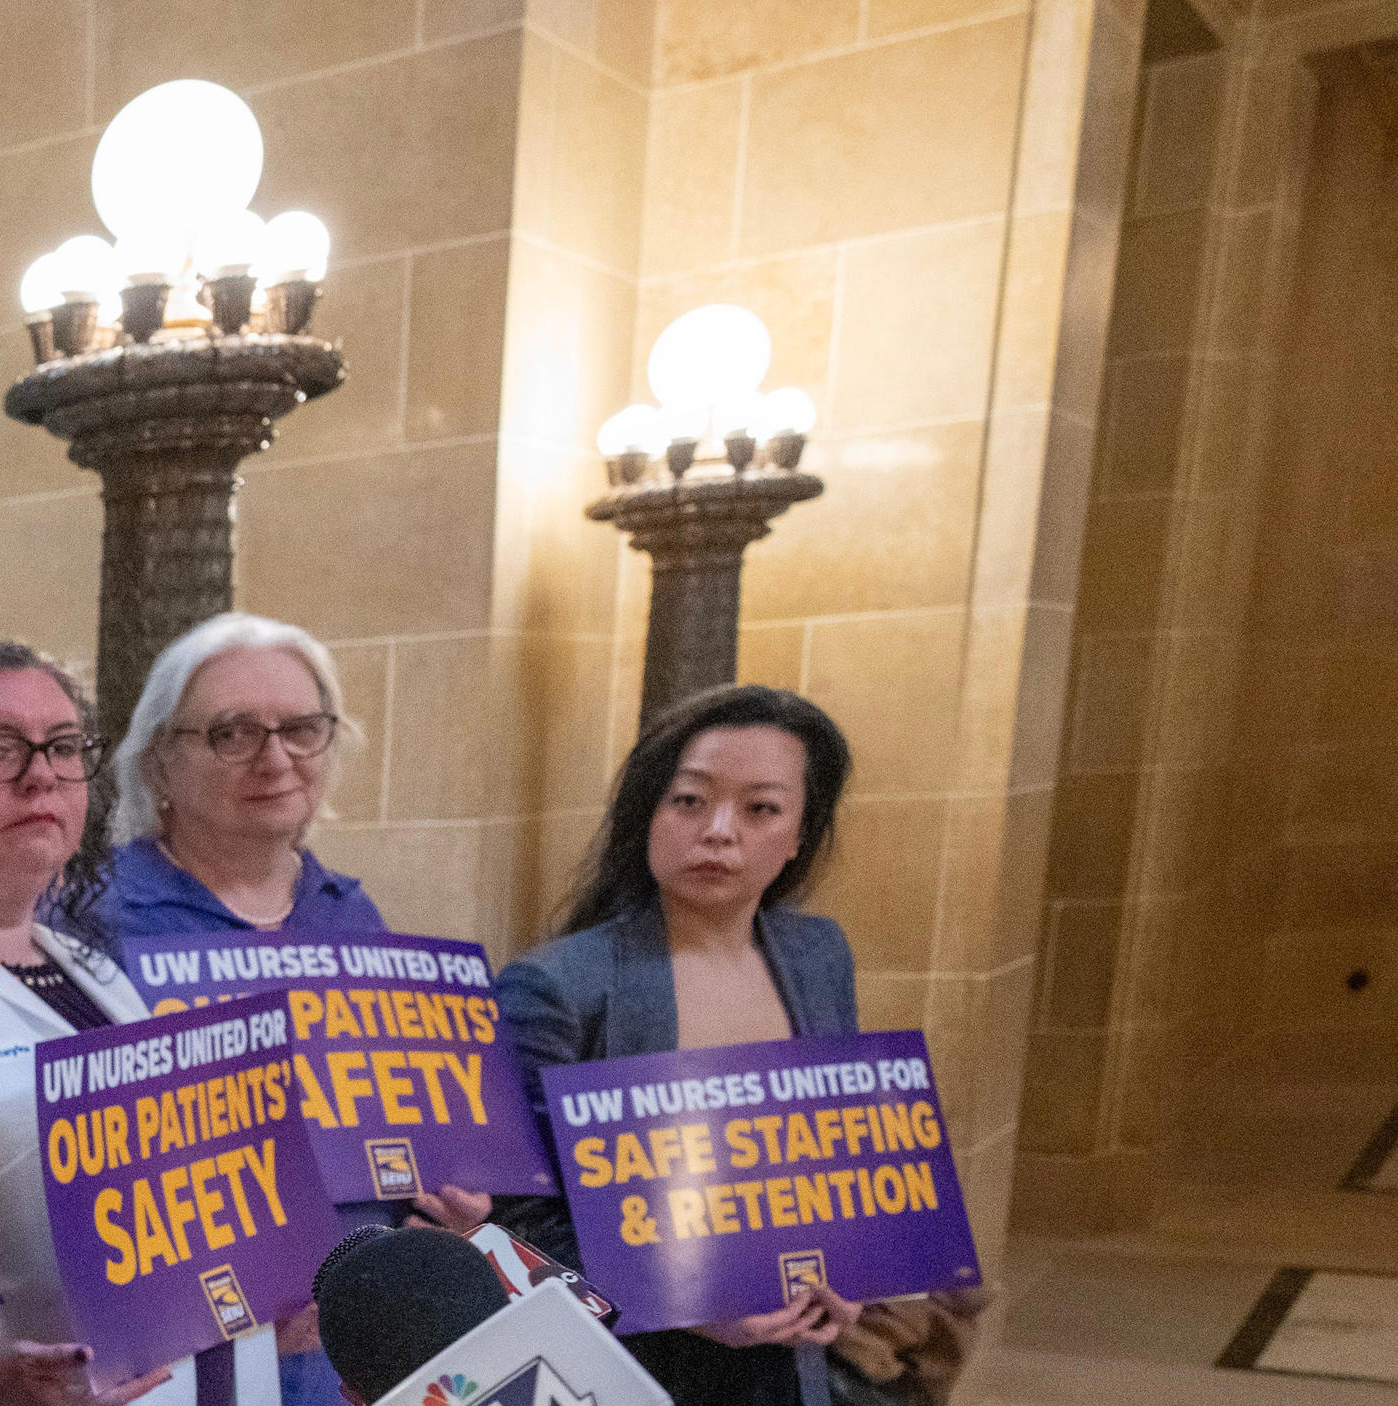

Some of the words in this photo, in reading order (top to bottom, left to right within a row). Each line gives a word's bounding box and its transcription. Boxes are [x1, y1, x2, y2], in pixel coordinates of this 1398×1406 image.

[139, 951, 200, 987] UW
[208, 946, 338, 981] NURSES
[340, 945, 438, 981] UNITED
[440, 953, 490, 988] FOR
[43, 1055, 84, 1103] UW
[88, 1036, 174, 1092] NURSES
[176, 1018, 248, 1070] UNITED
[249, 1009, 287, 1051] FOR
[293, 1050, 488, 1128] AFETY
[562, 1089, 624, 1127] UW
[630, 1071, 765, 1118] NURSES
[768, 1061, 877, 1101] UNITED
[879, 1058, 929, 1091] FOR
[48, 1105, 131, 1184] OUR
[136, 1061, 290, 1159] PATIENTS'
[574, 1123, 717, 1188] SAFE
[725, 1101, 941, 1168] STAFFING
[94, 1138, 288, 1285] SAFETY
[620, 1195, 660, 1246] &
[667, 1162, 938, 1240] RETENTION
